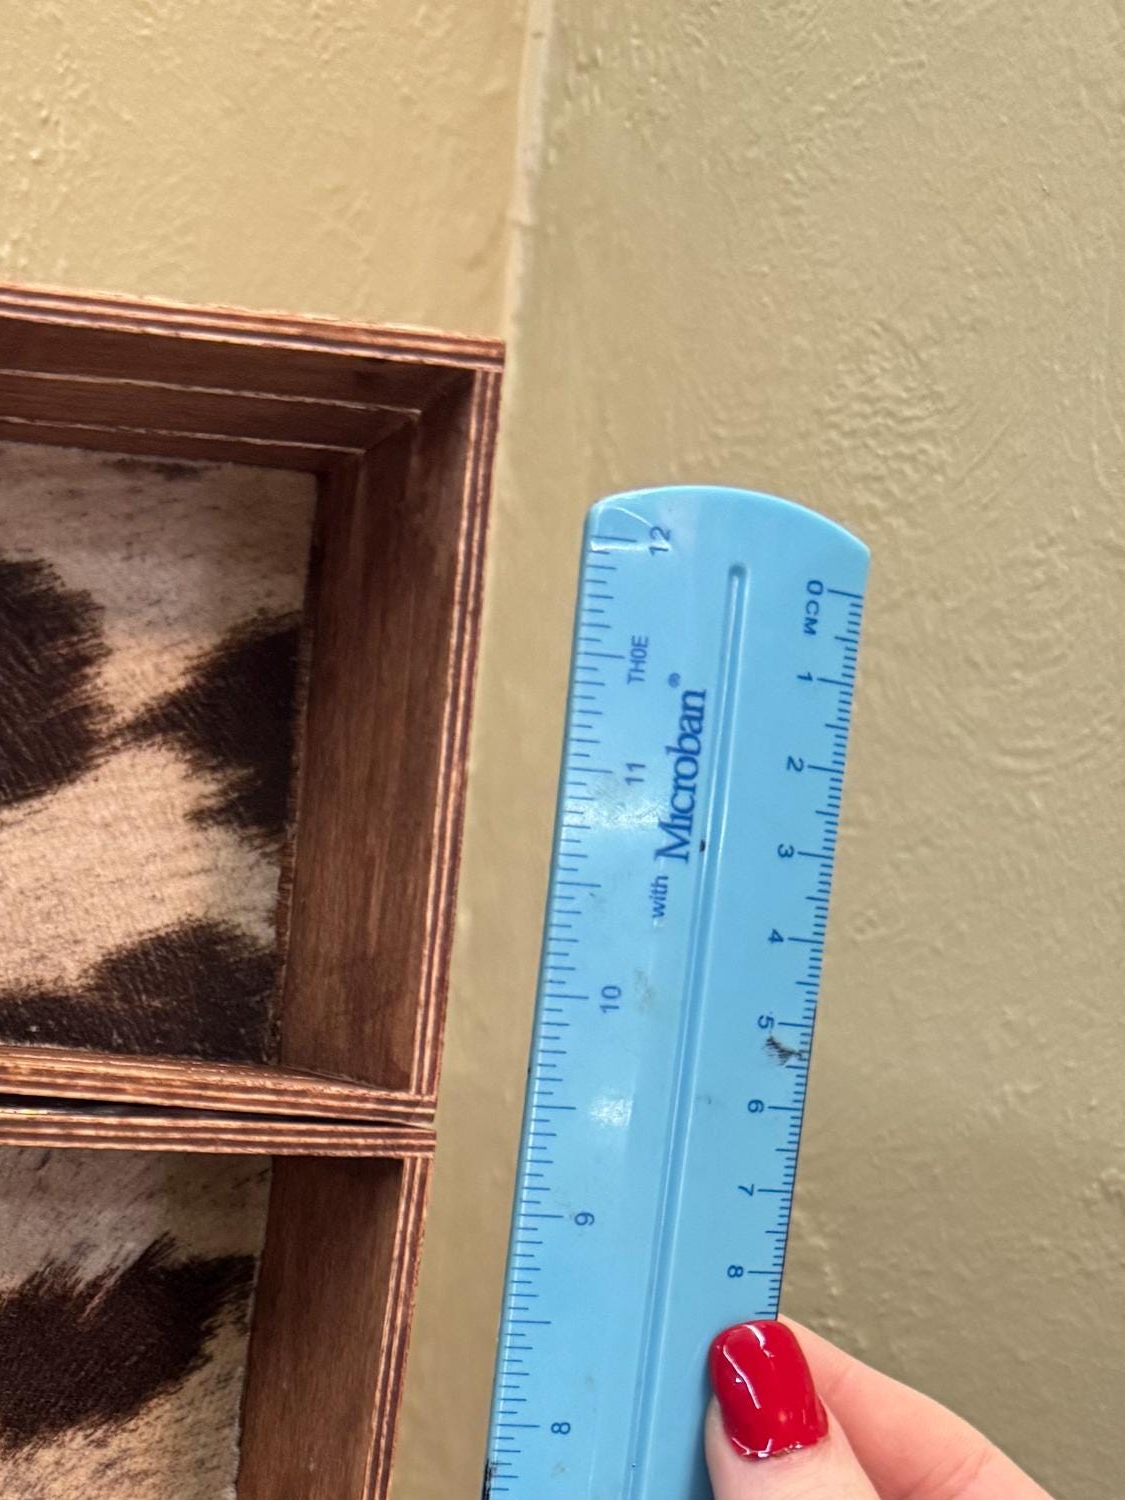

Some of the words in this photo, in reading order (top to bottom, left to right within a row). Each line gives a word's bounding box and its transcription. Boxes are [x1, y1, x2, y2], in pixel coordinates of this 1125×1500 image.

[649, 525, 671, 557] 12
[798, 672, 813, 682] 1
[626, 761, 646, 784] 11
[786, 757, 805, 773] 2
[778, 845, 795, 859] 3
[650, 875, 668, 918] with
[768, 929, 784, 944] 4
[600, 985, 622, 1014] 10
[758, 1015, 775, 1031] 5
[747, 1099, 764, 1115] 6
[738, 1183, 754, 1198] 7
[575, 1211, 595, 1228] 9
[726, 1264, 744, 1279] 8
[550, 1421, 571, 1435] 8
